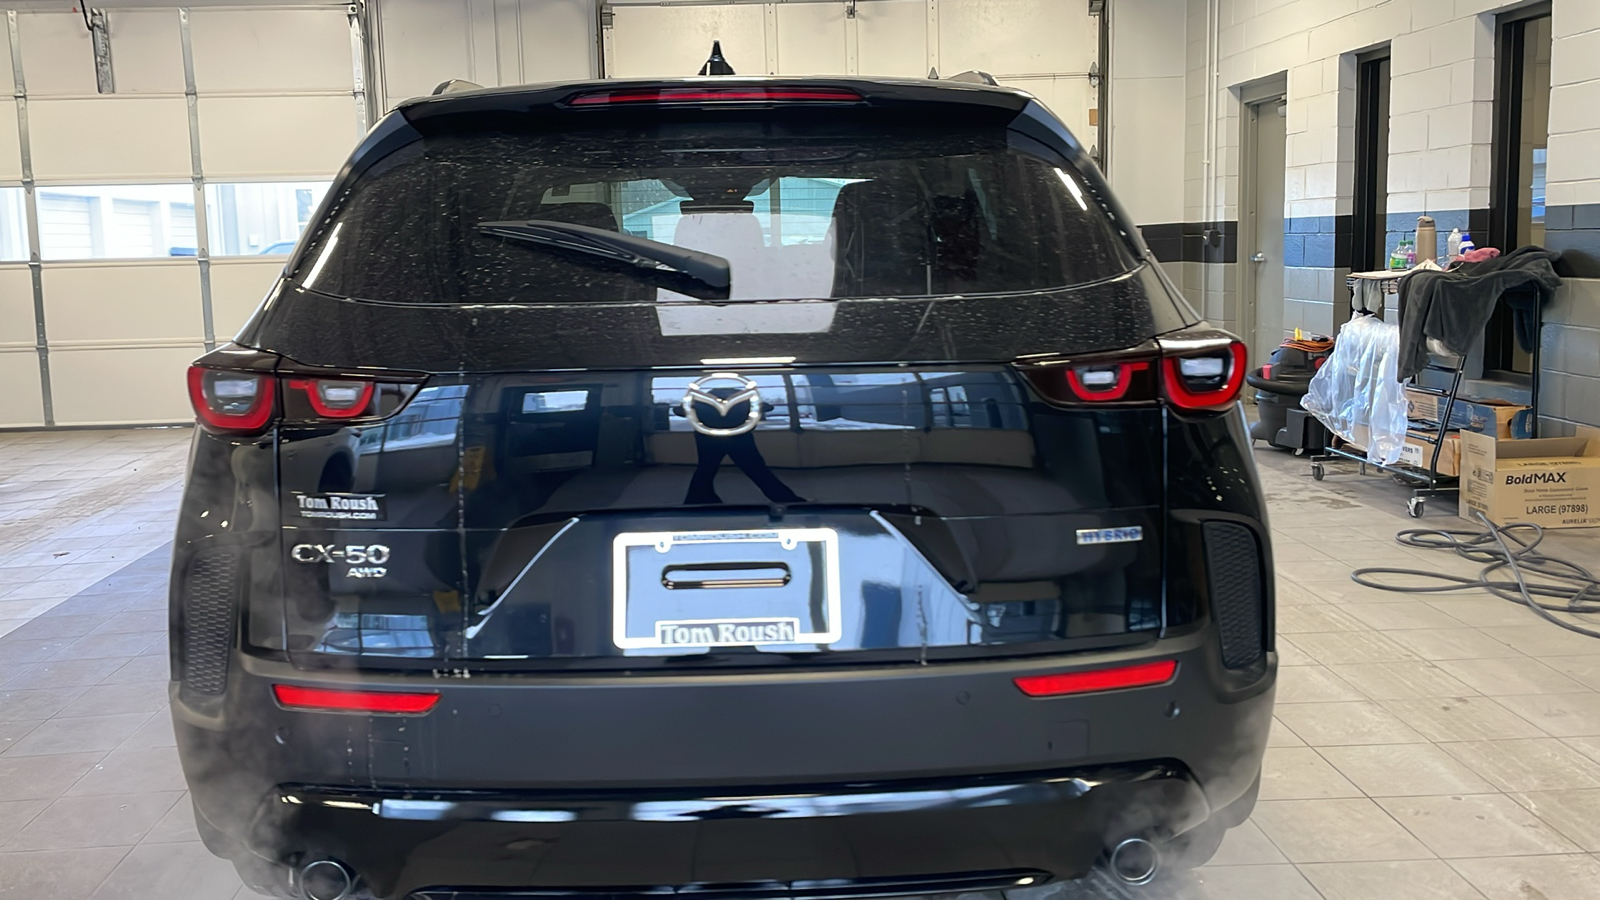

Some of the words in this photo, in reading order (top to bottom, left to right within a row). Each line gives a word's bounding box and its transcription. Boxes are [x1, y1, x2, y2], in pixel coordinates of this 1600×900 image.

[1505, 471, 1567, 485] BoldMAX
[296, 495, 329, 509] Tom
[330, 496, 379, 511] Roush
[1526, 505, 1557, 515] LARGE
[1558, 504, 1588, 515] (97898)
[1079, 527, 1141, 542] HYBRID
[291, 543, 390, 564] CX-50
[346, 567, 388, 578] AWD
[661, 624, 714, 644] Tom
[718, 622, 795, 642] Roush
